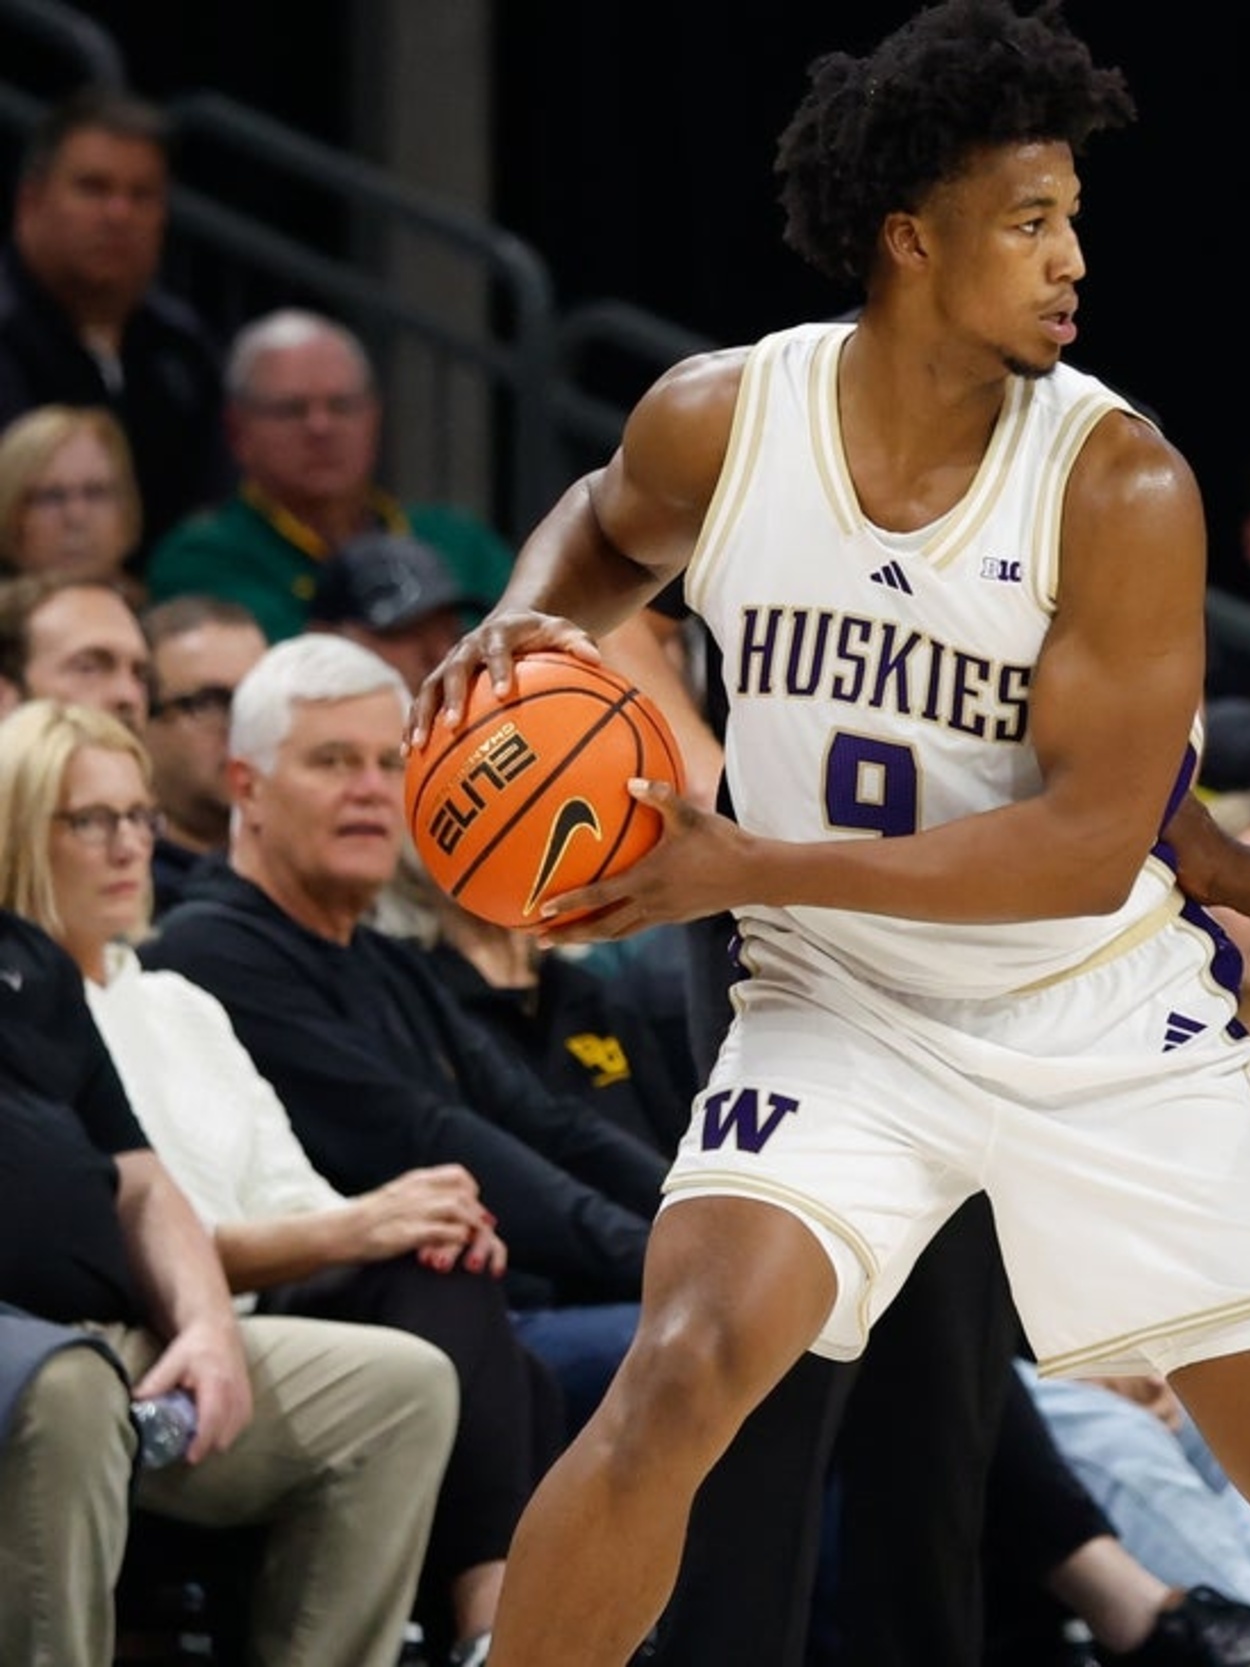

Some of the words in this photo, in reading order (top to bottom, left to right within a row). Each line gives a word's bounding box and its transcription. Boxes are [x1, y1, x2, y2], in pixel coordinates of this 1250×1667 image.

[736, 604, 1030, 744] HUSKIES
[429, 733, 539, 857] ELITE
[821, 727, 922, 838] 9
[701, 1088, 799, 1154] W
